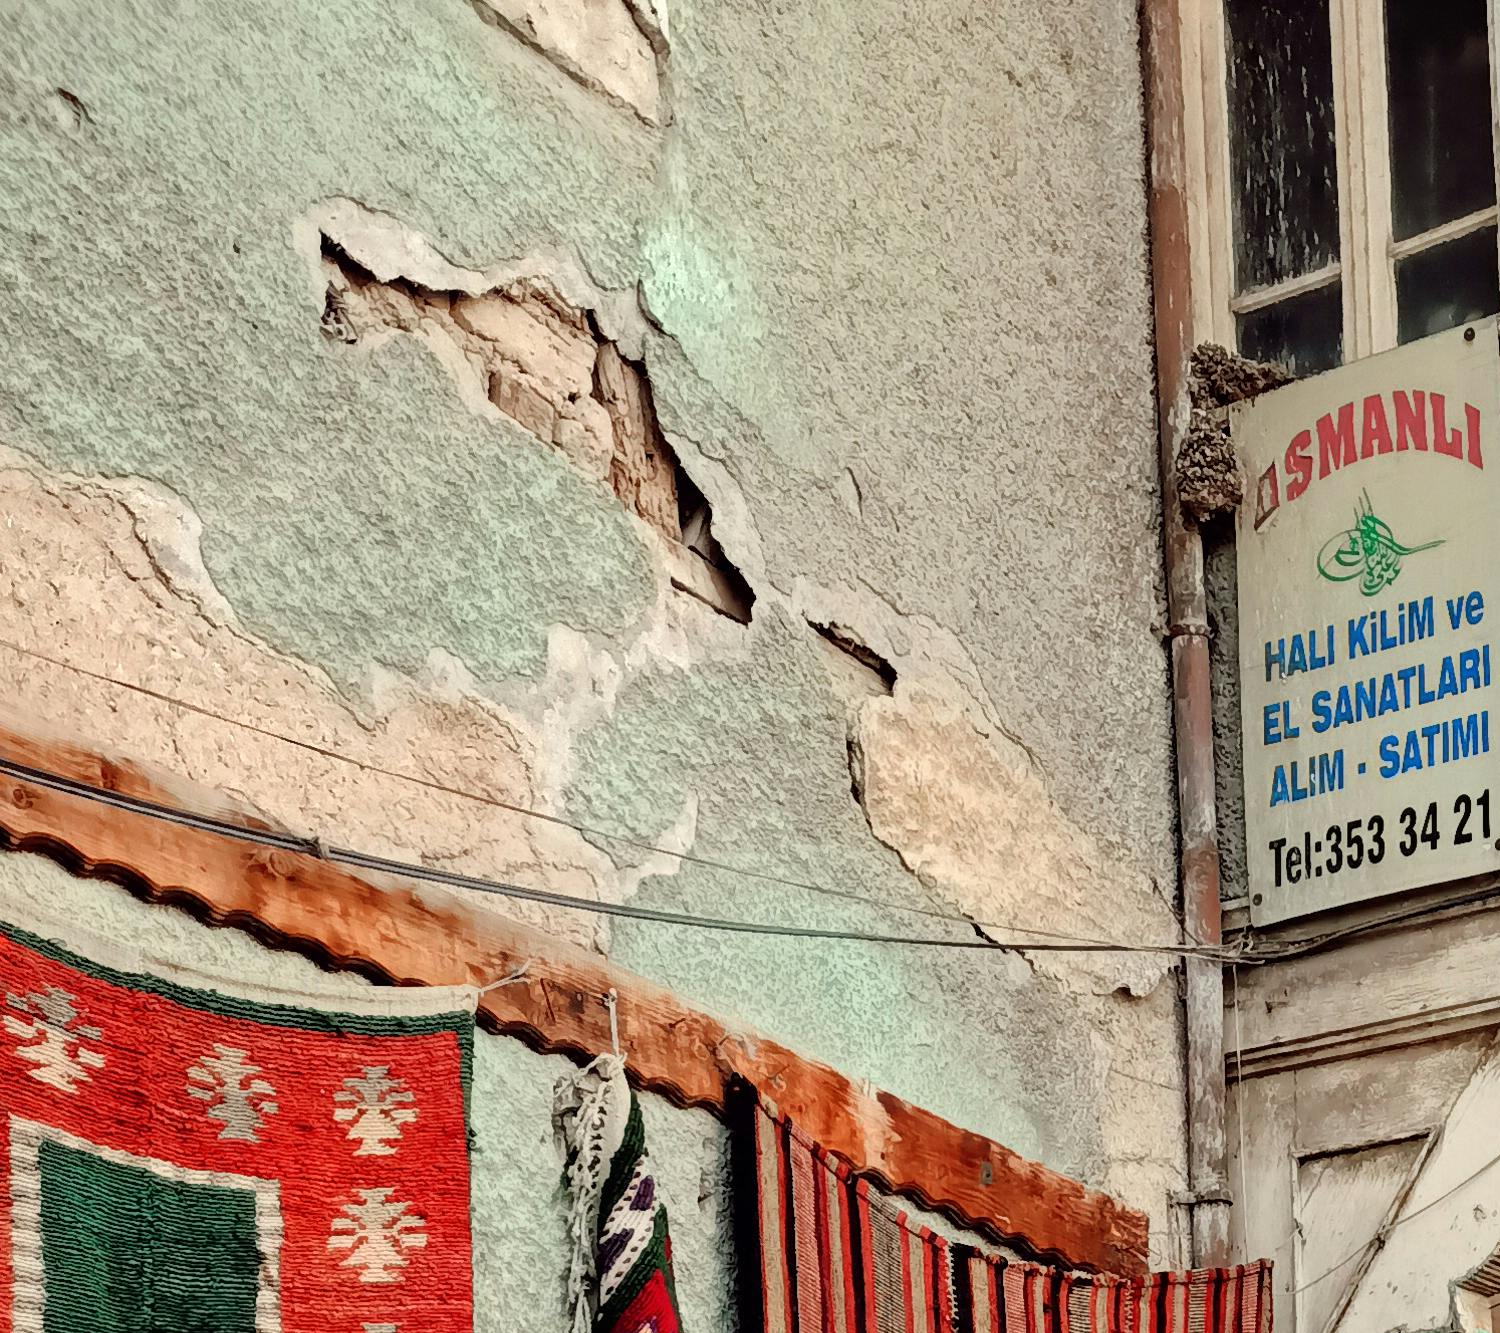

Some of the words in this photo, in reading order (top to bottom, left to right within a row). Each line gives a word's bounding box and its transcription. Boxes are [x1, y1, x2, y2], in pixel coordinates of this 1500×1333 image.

[1254, 389, 1484, 531] OSMANLI
[1265, 625, 1335, 683] HALI
[1447, 590, 1484, 631] ve
[1263, 701, 1300, 746] EL
[1312, 644, 1491, 734] SANATLARI
[1269, 748, 1344, 808] ALIM
[1379, 710, 1490, 779] SATIMI
[1400, 801, 1440, 857] 34
[1454, 788, 1491, 845] 21
